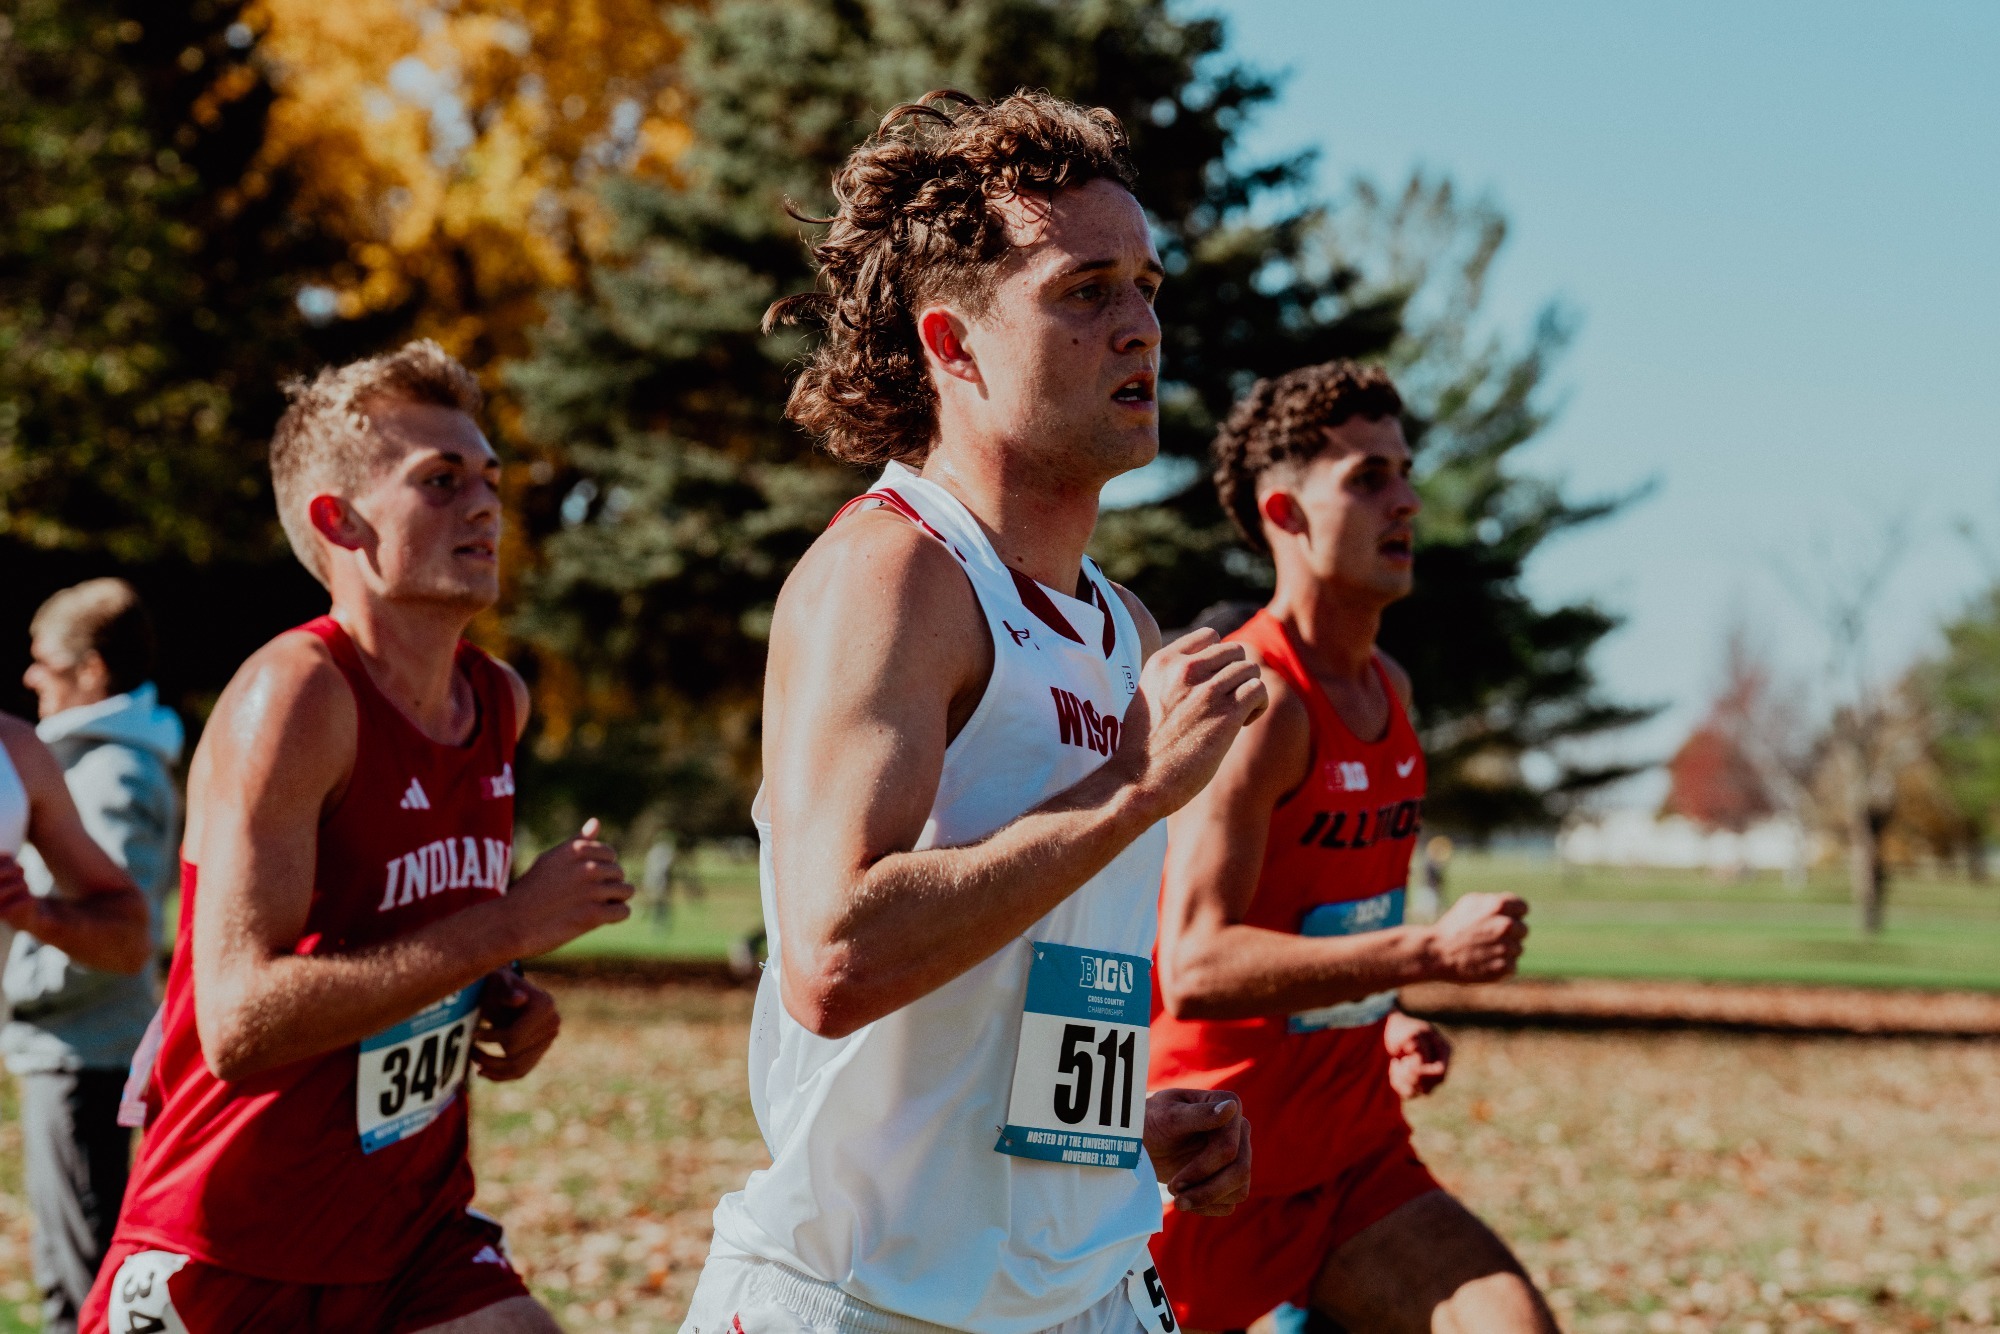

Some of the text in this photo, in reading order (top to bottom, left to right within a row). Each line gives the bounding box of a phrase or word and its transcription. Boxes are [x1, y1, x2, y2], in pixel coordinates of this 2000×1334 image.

[1087, 995, 1125, 1006] CROSS COUNTRY
[1087, 1006, 1124, 1017] CHAMPIONSHIPS
[379, 1024, 464, 1118] 346
[1054, 1023, 1136, 1129] 511
[1026, 1131, 1057, 1145] HOSTED
[1057, 1133, 1069, 1147] BY
[1069, 1135, 1082, 1148] THE
[1082, 1137, 1117, 1151] UNIVERSITY
[1117, 1140, 1124, 1152] OF
[1062, 1149, 1120, 1166] NOVEMBER 1, 2024
